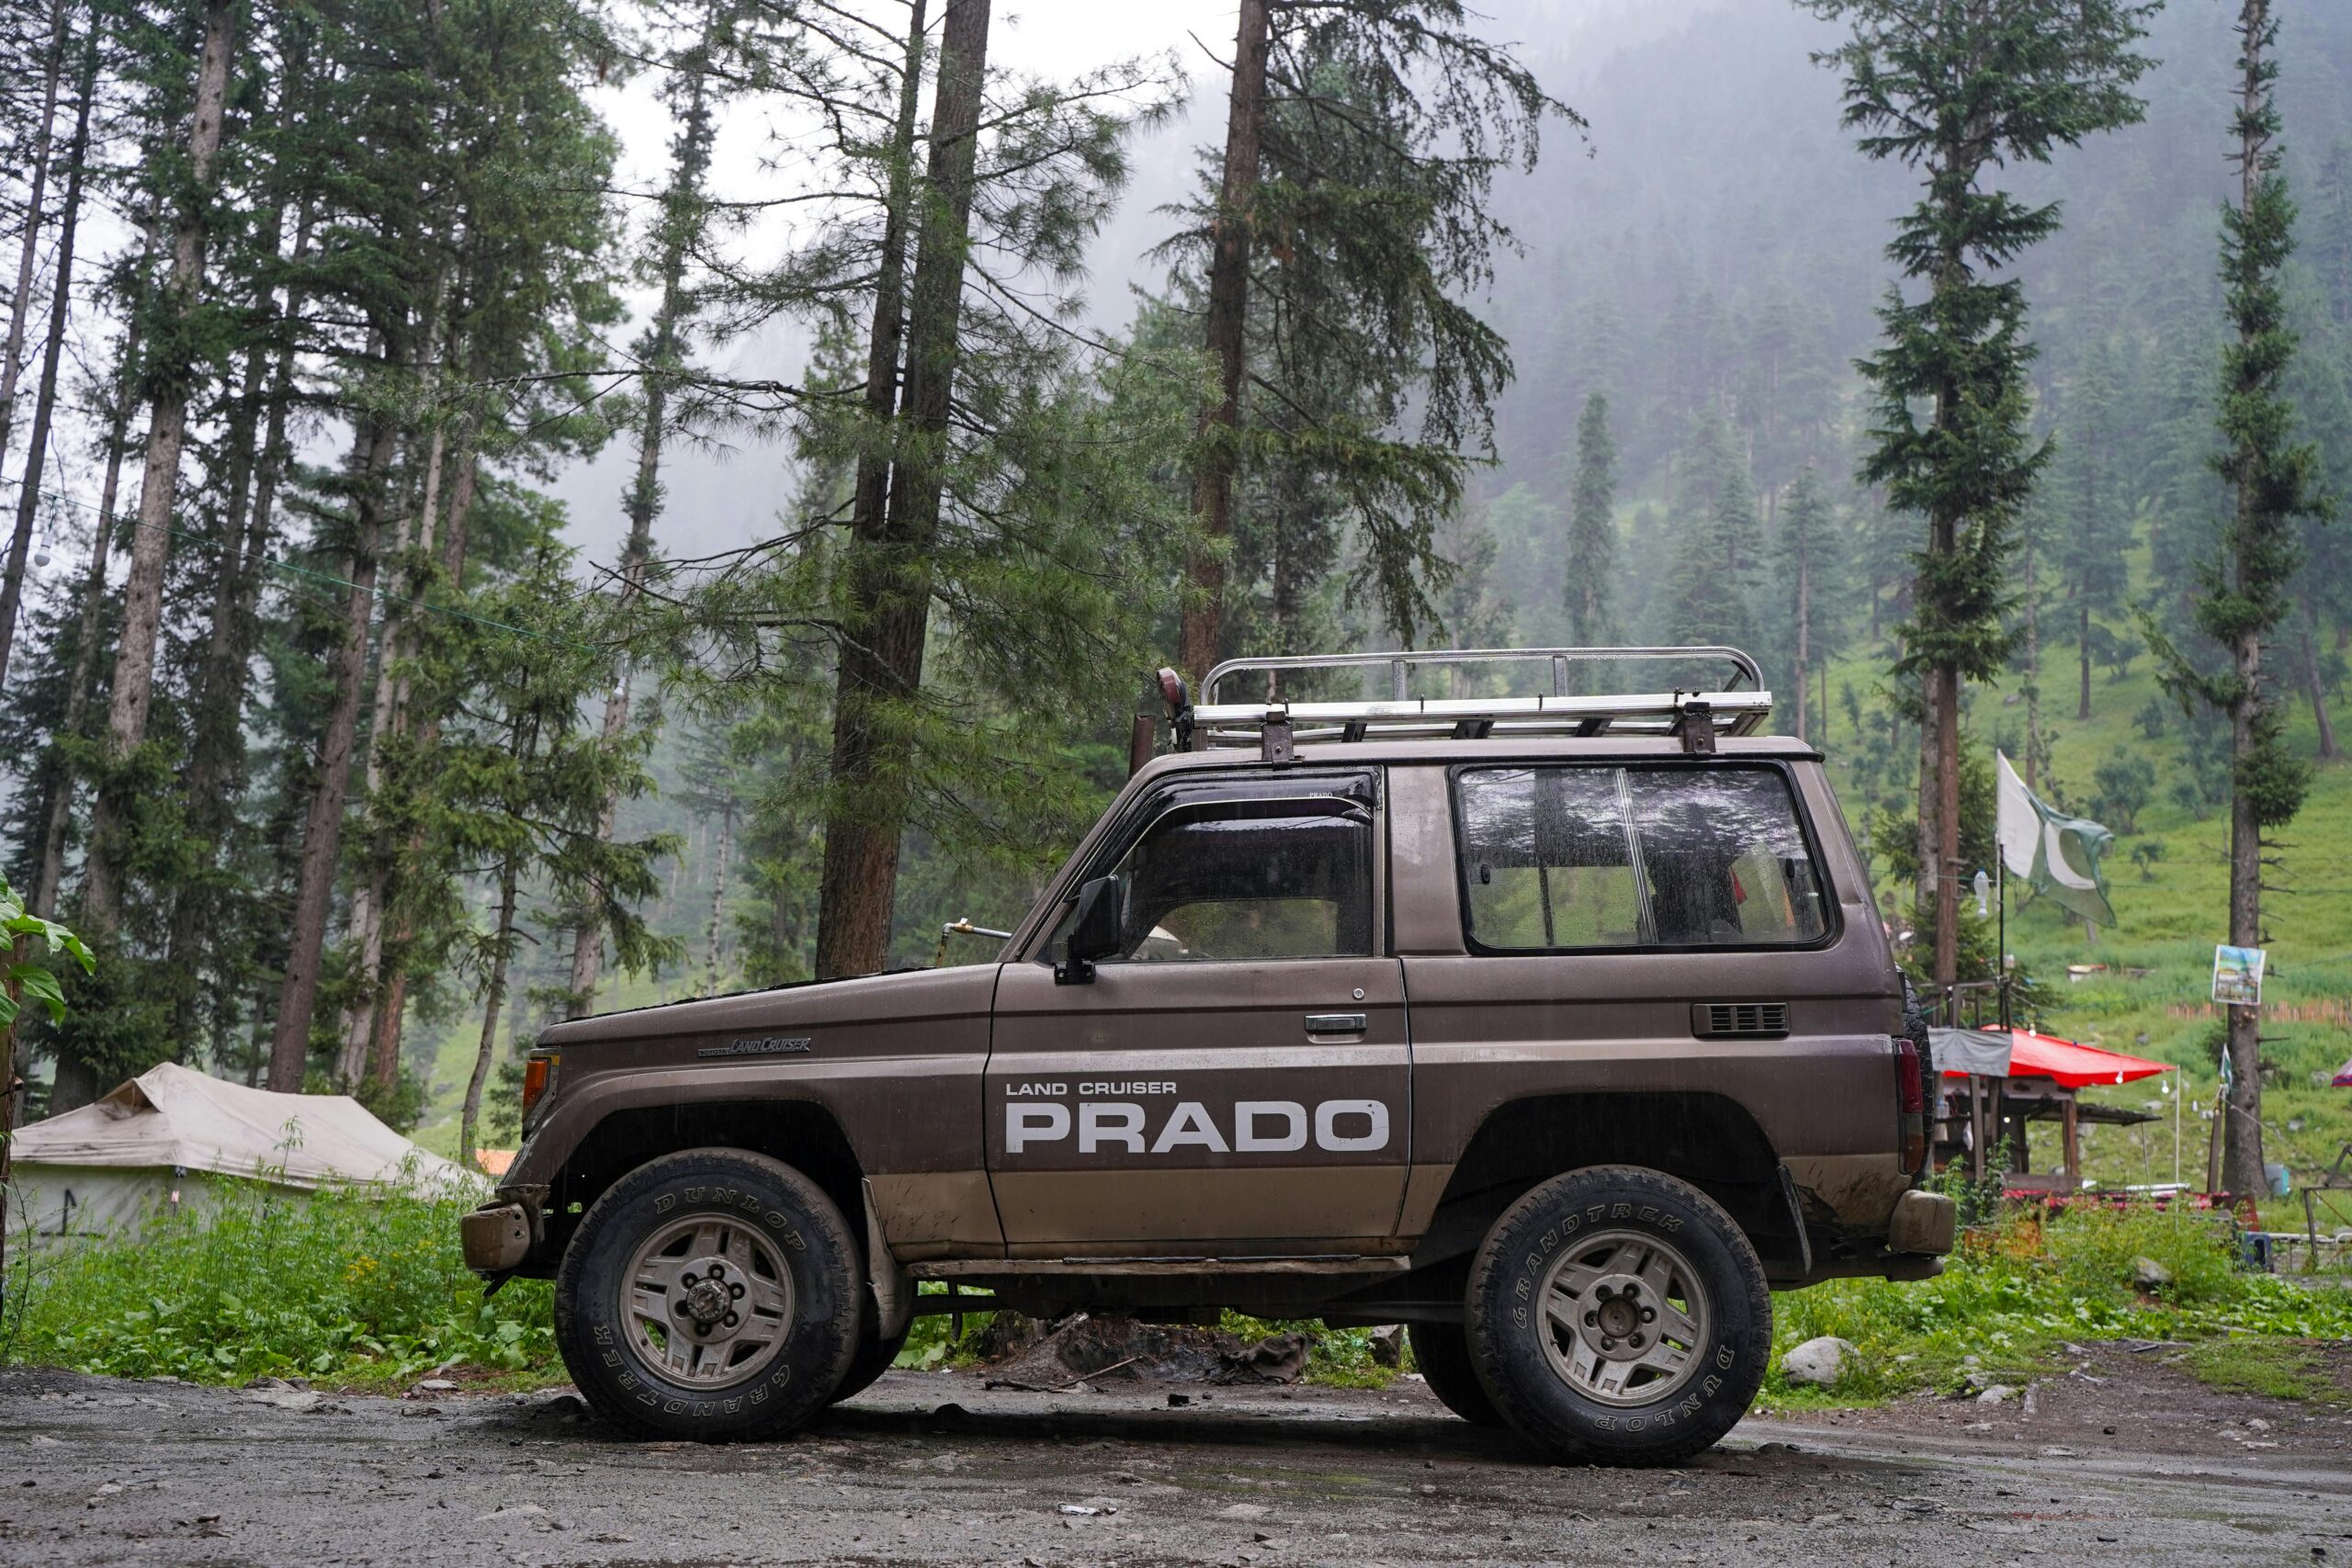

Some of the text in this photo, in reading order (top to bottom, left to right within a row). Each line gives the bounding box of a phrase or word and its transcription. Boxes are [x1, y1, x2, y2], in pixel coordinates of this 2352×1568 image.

[1006, 1081, 1177, 1096] LAND CRUISER
[1005, 1100, 1389, 1154] PRADO
[654, 1187, 807, 1251] DUNLOP
[1512, 1203, 1684, 1329] GRANDTREK
[594, 1325, 791, 1417] GRANDTREK
[1594, 1344, 1736, 1433] DUNLOP
